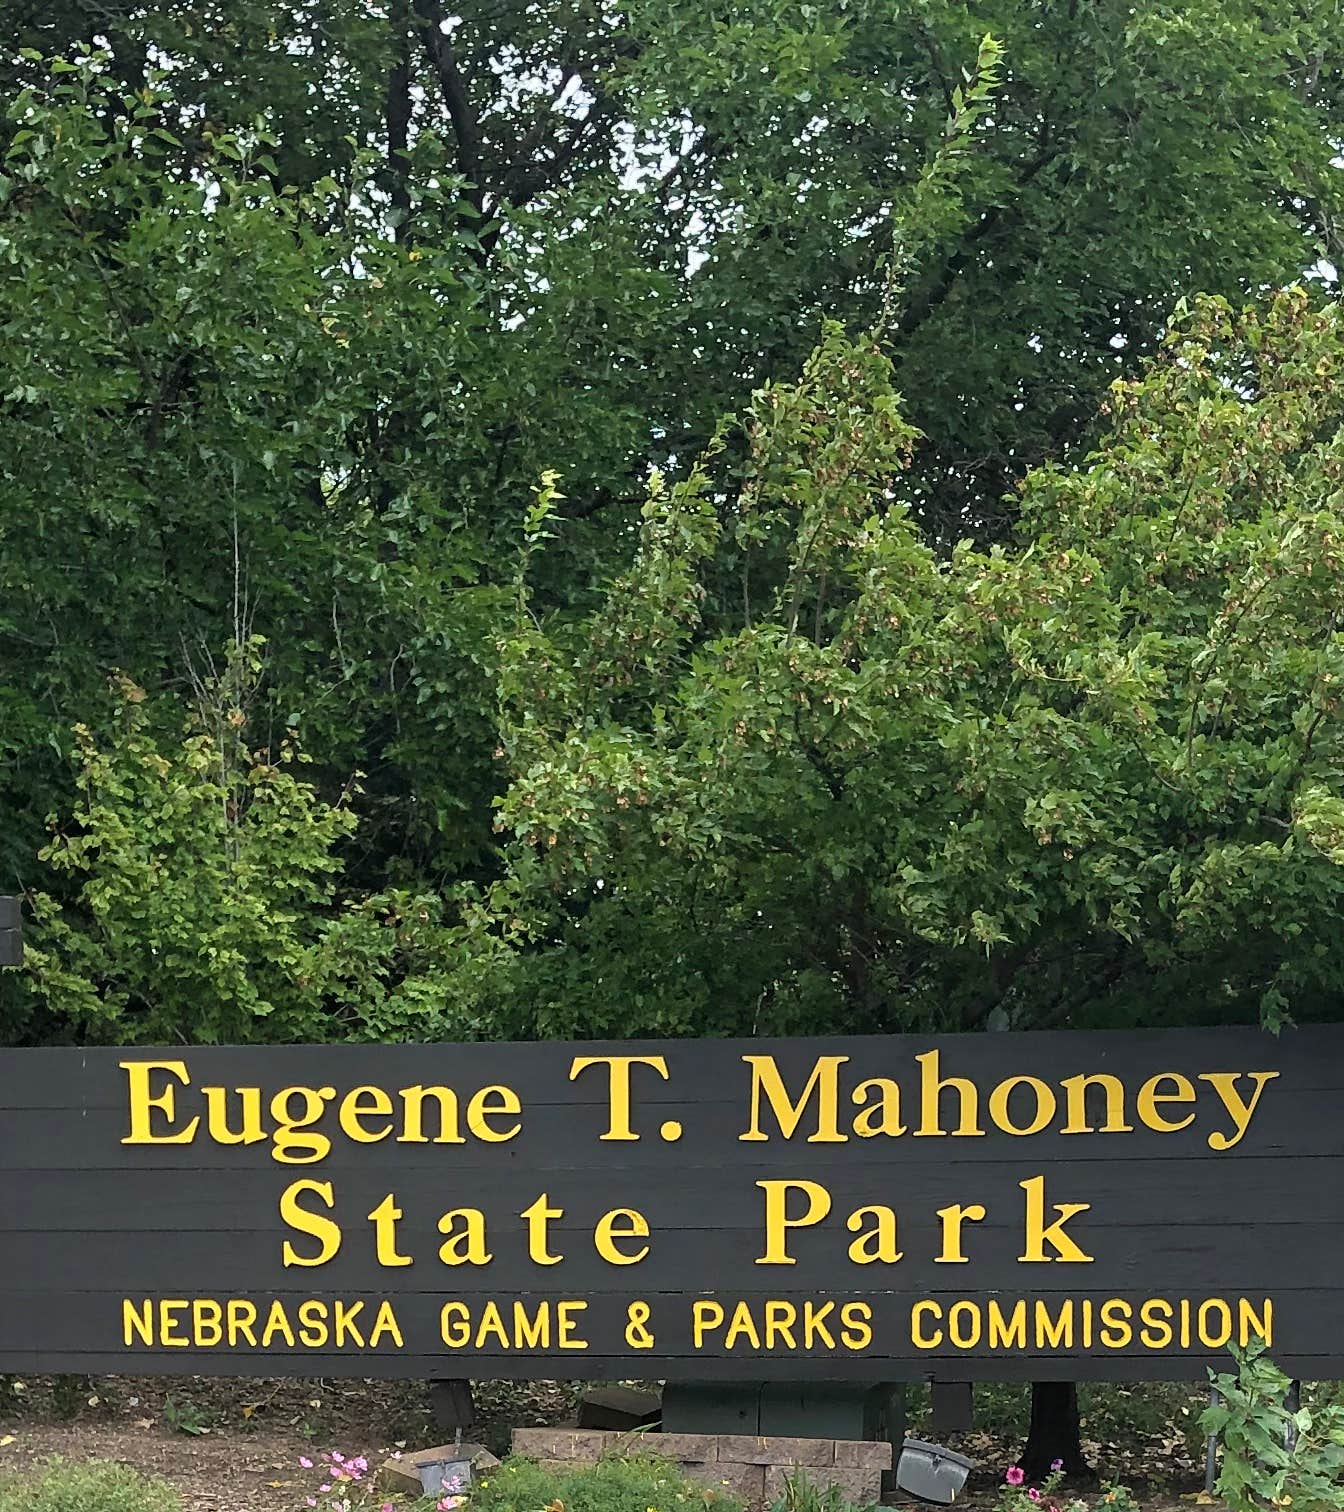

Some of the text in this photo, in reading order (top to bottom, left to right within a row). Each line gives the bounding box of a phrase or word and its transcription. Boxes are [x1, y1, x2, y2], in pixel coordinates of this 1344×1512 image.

[119, 1049, 1281, 1164] Eugene T. Mahoney
[279, 1175, 1094, 1268] State Park
[122, 1298, 1273, 1350] NEBRASKA GAME & PARKS COMMISSION
